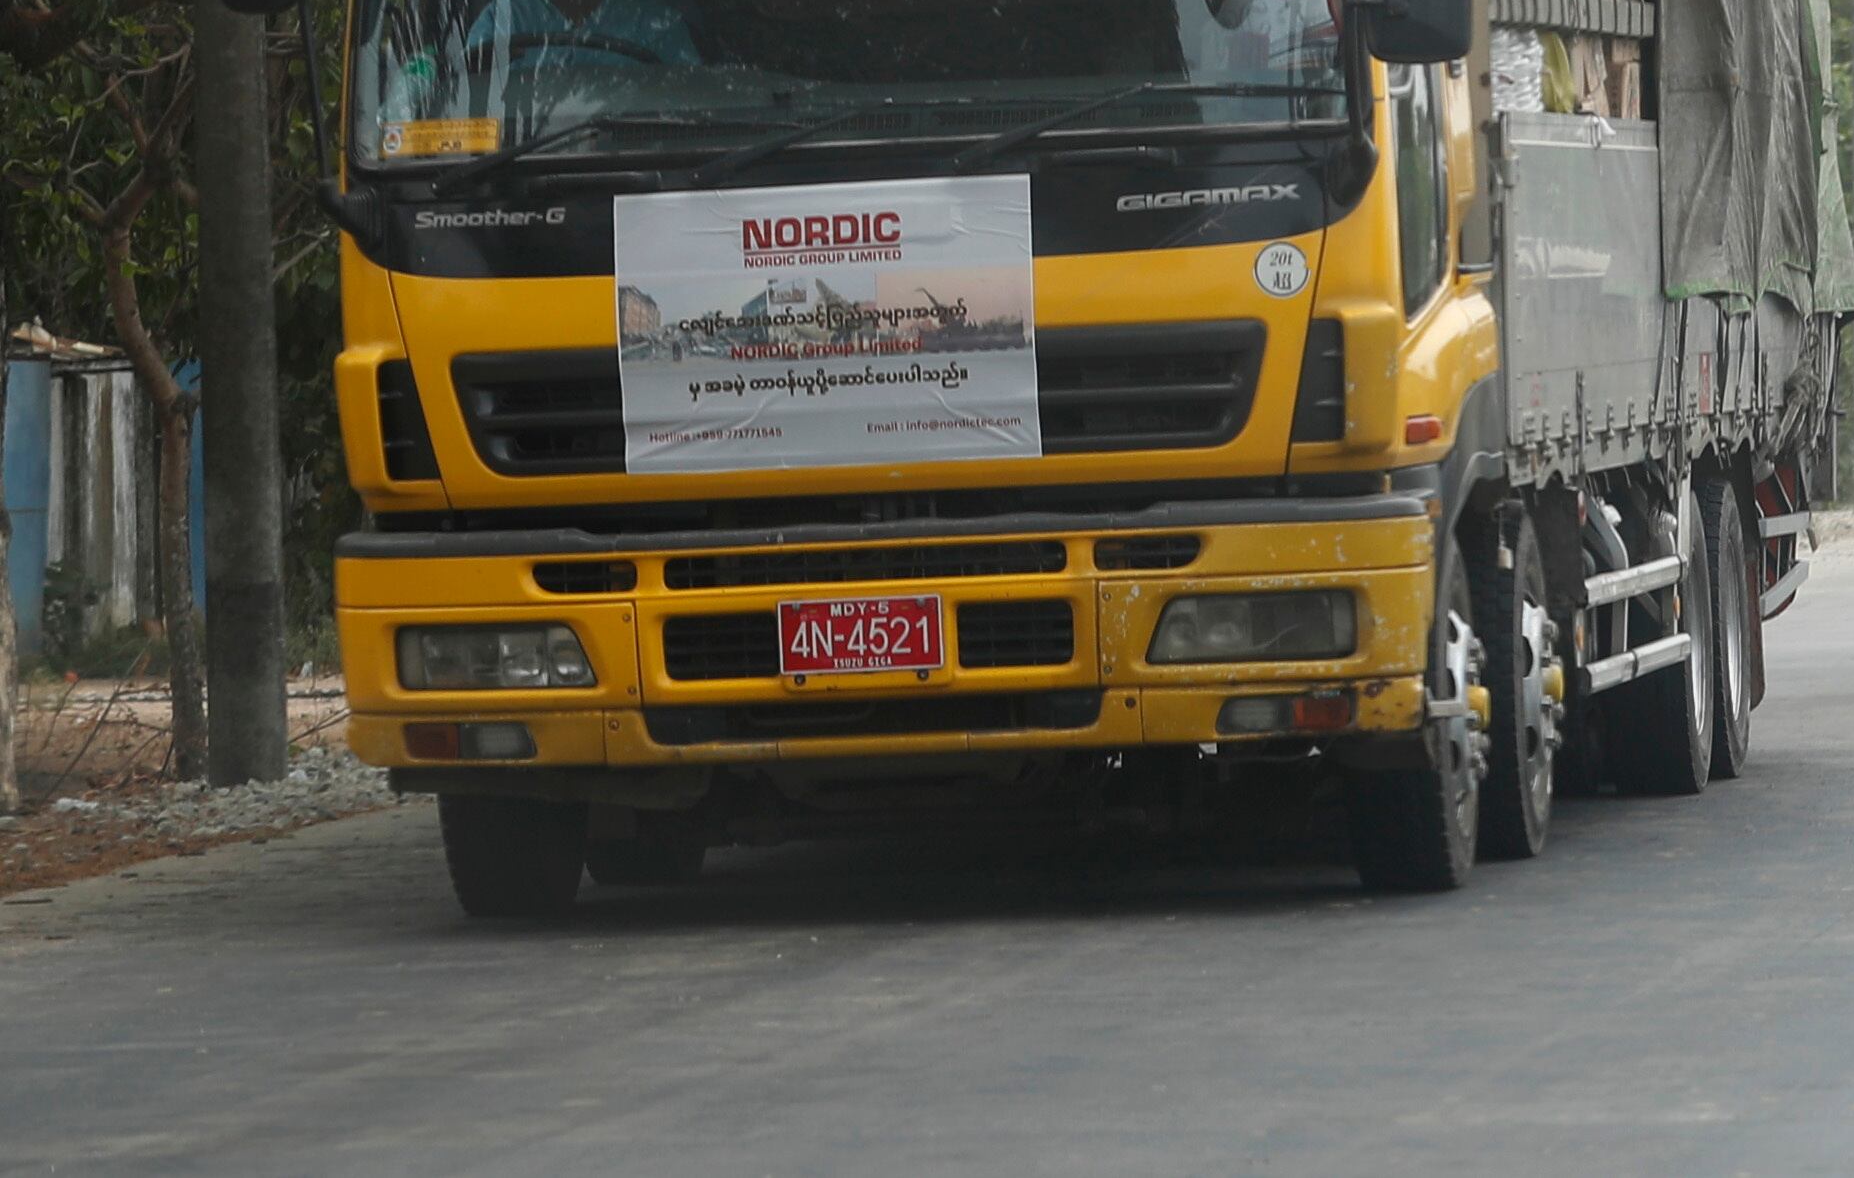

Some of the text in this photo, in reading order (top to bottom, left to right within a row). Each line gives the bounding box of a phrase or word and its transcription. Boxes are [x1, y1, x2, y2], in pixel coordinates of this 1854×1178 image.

[1116, 183, 1301, 212] GIGAMAX
[742, 211, 901, 250] NORDIC
[744, 249, 902, 269] NORDIC GROUP LIMITED
[730, 335, 923, 360] NORDIC Group Limited
[867, 422, 898, 433] Email
[791, 615, 929, 659] 4N-4521
[833, 657, 863, 669] ISUZU
